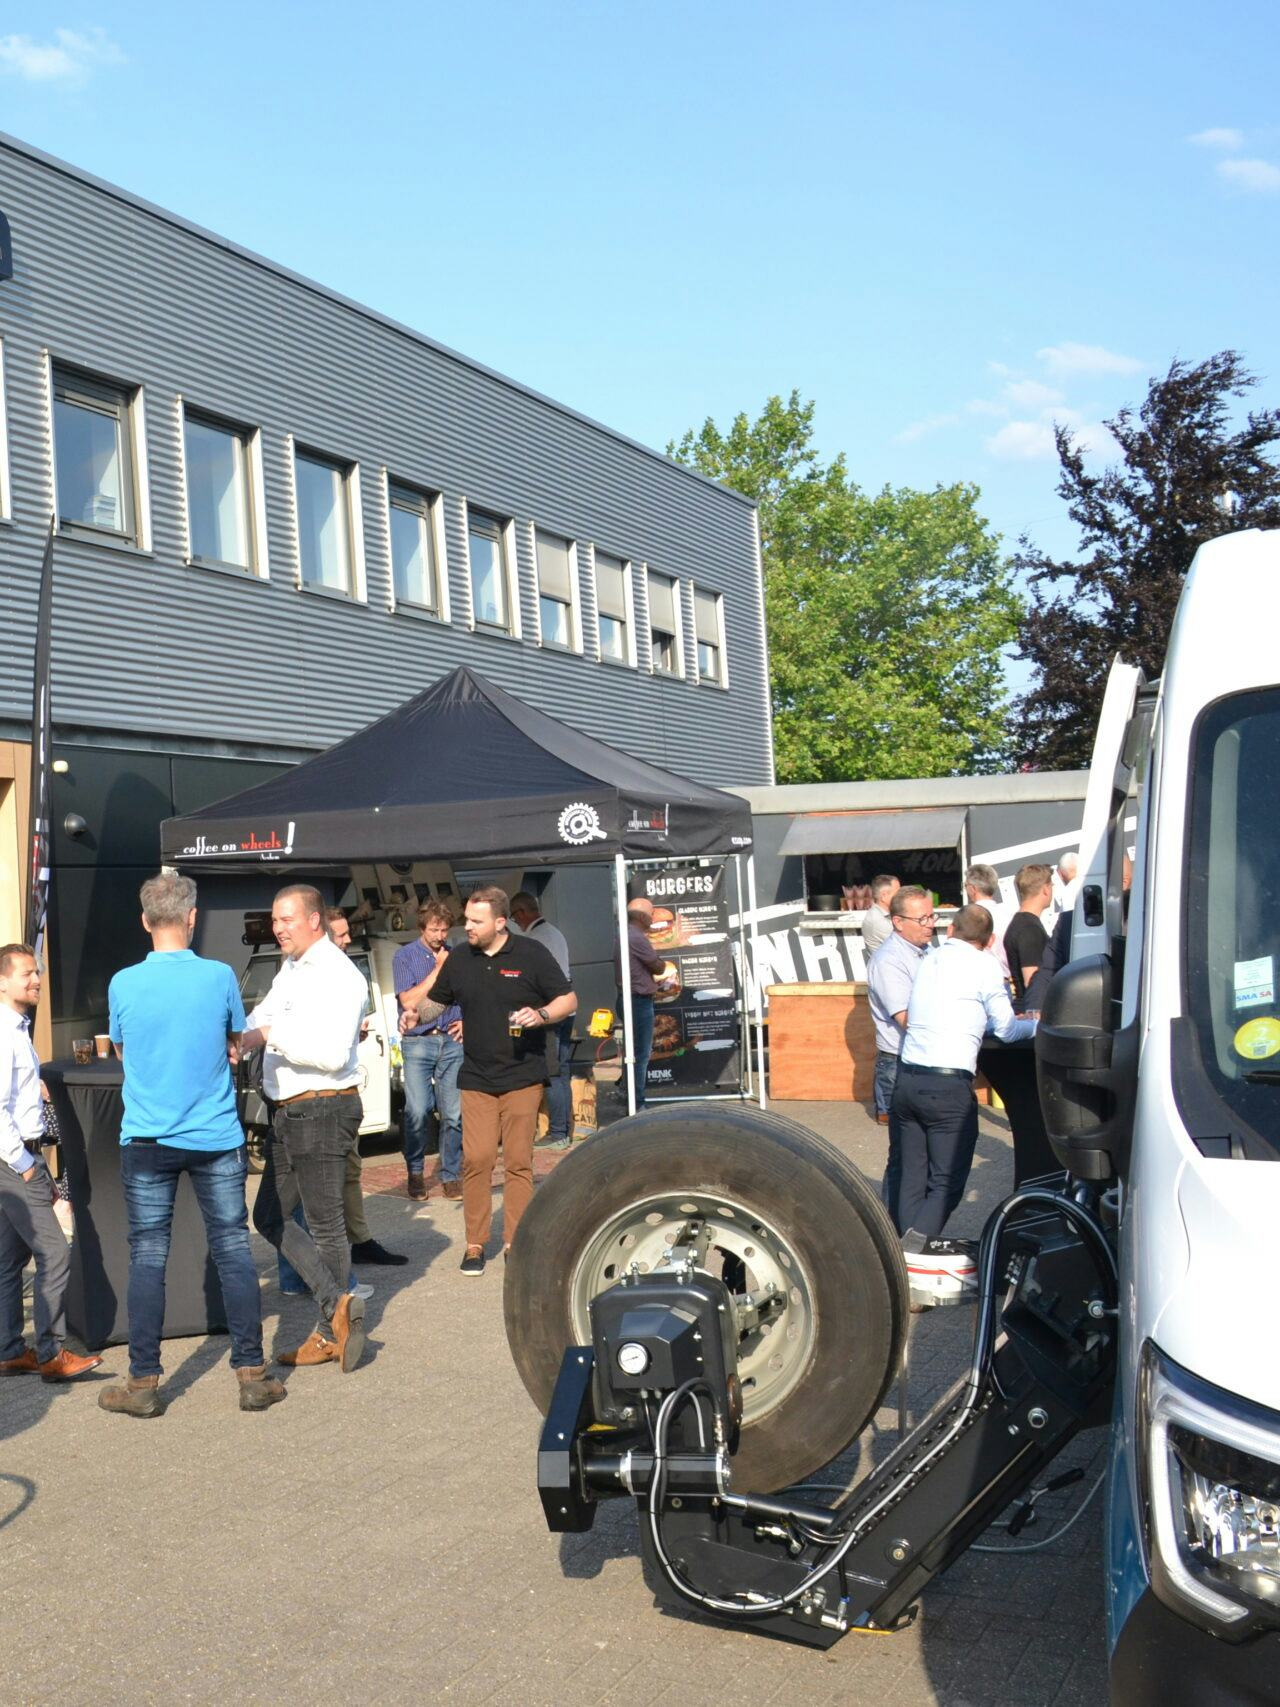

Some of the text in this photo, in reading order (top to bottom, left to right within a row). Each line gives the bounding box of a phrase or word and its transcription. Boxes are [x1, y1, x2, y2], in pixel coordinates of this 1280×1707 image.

[183, 836, 218, 855] coffee
[222, 843, 236, 852] on
[646, 876, 713, 896] BURGERS
